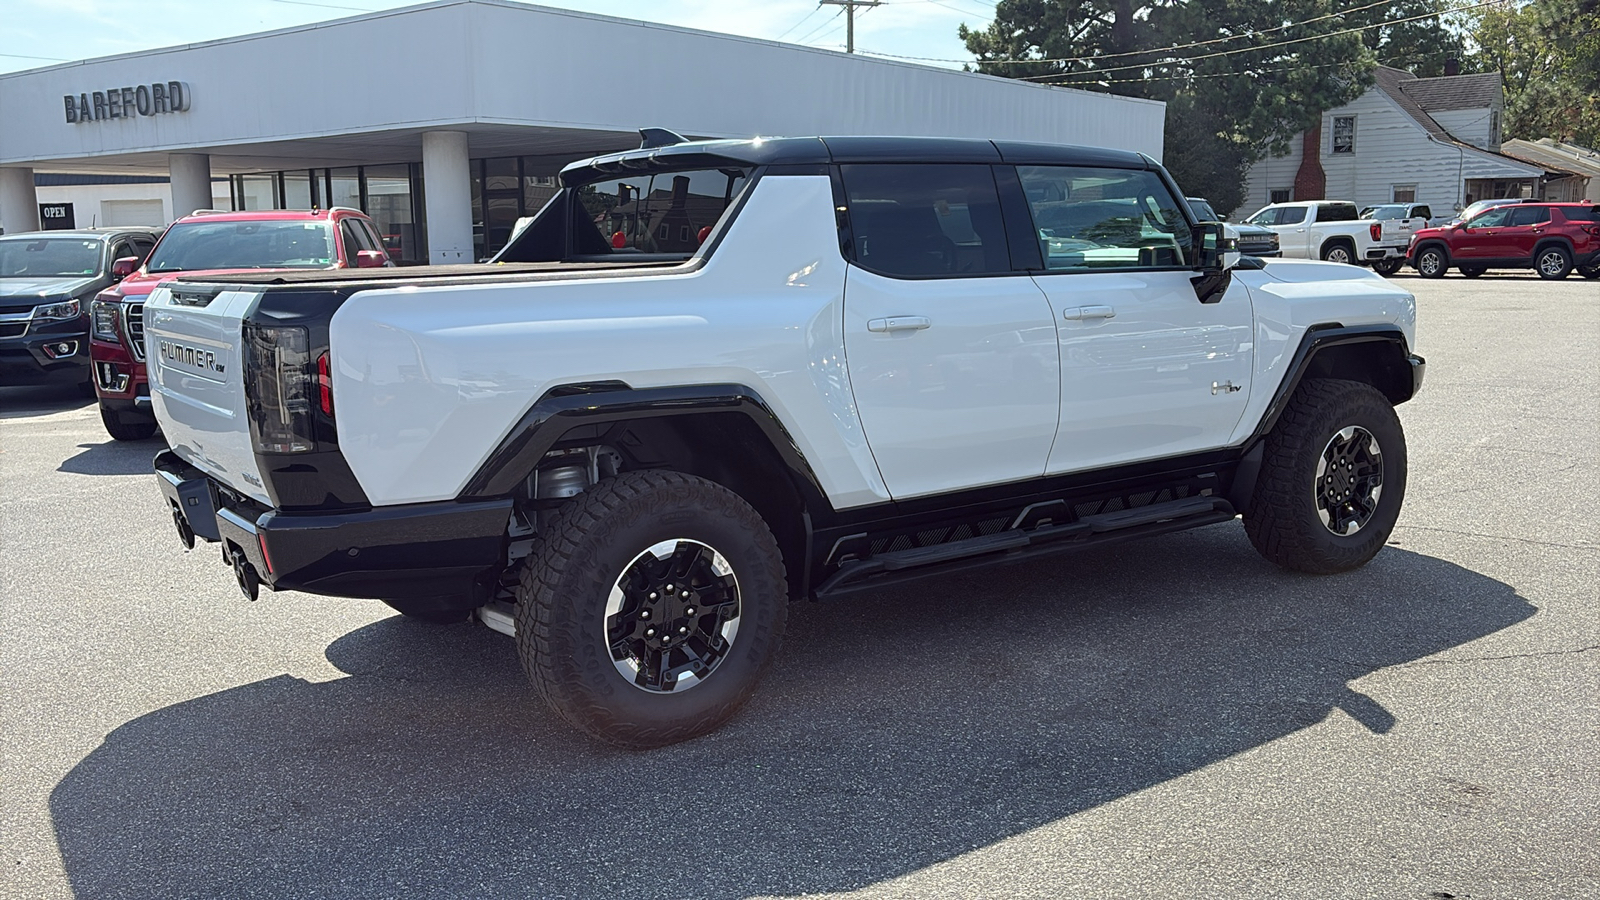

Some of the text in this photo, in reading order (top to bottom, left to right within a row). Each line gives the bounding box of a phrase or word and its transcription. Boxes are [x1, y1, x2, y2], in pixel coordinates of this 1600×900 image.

[64, 81, 188, 123] BAREFORD
[44, 206, 66, 218] OPEN
[161, 340, 216, 371] HUMMER
